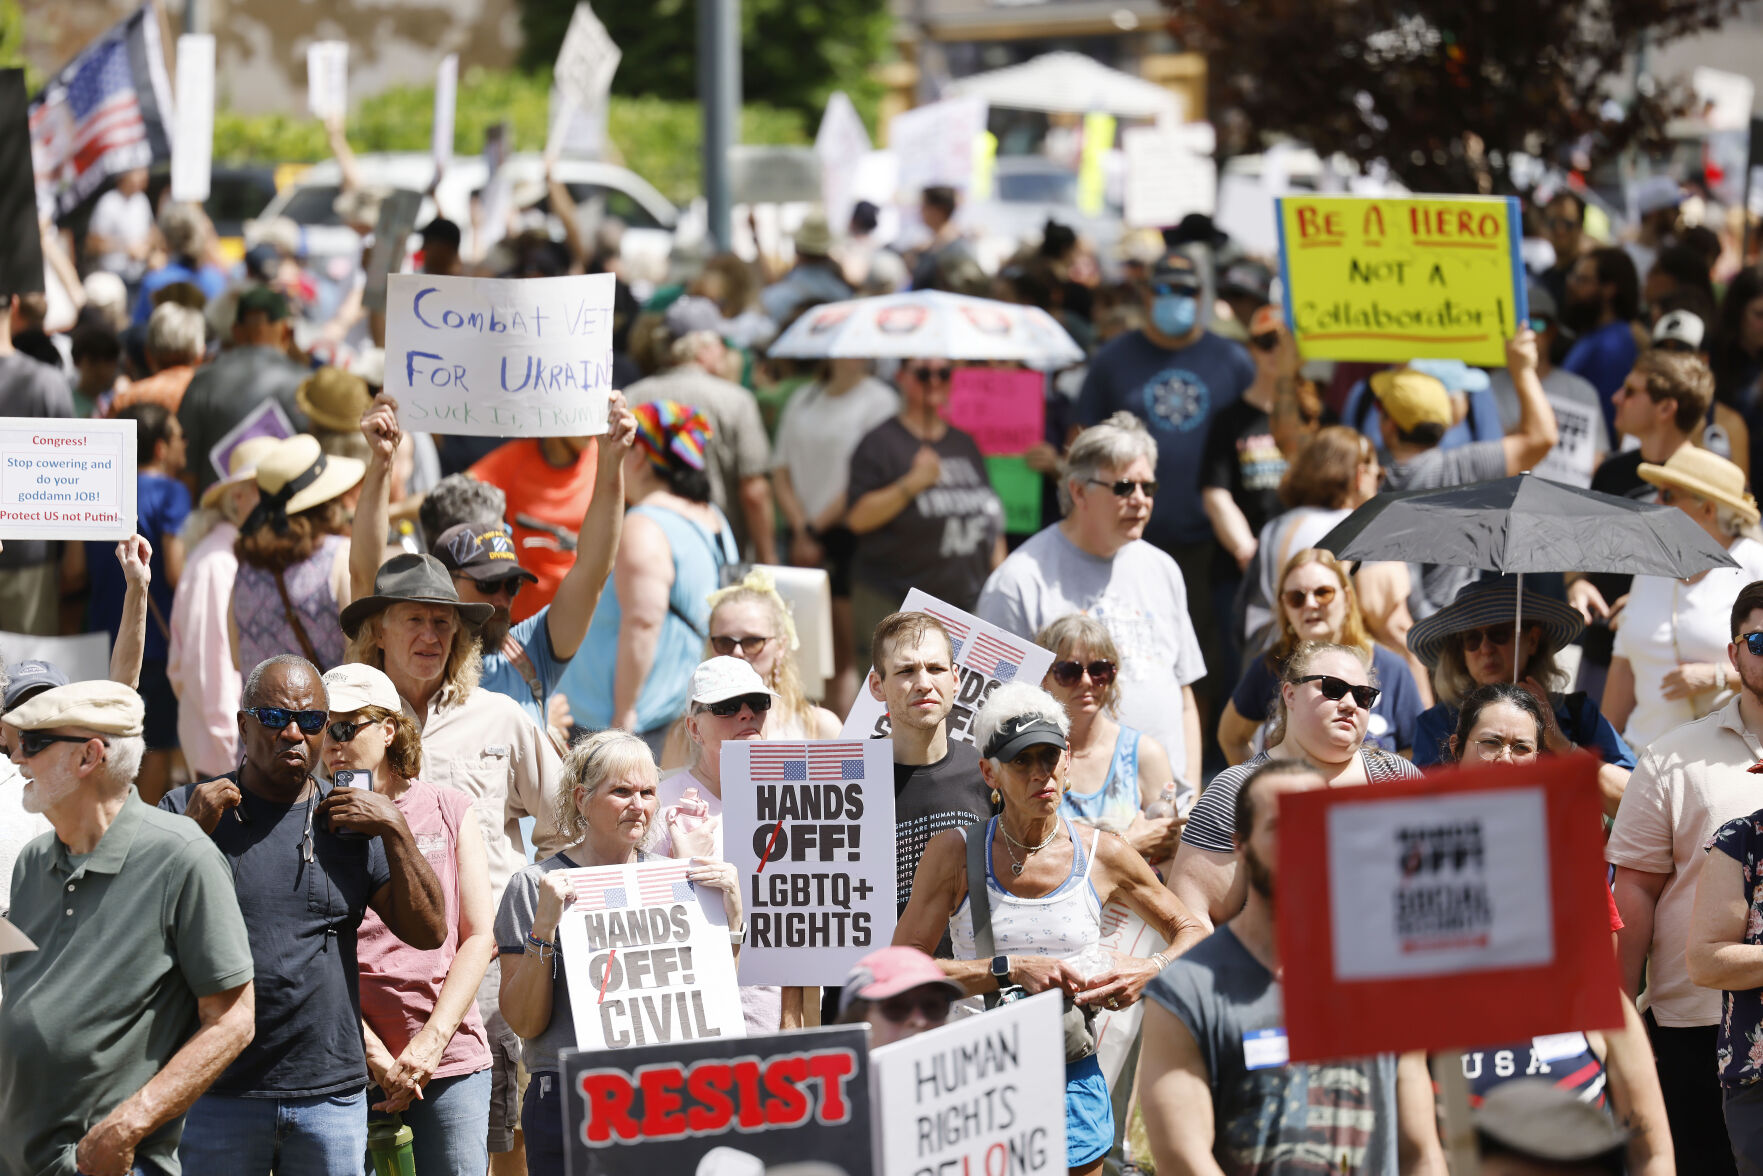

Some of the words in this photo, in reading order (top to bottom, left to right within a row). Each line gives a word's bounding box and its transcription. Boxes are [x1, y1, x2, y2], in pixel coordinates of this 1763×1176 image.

[1297, 205, 1345, 238] BE
[1363, 205, 1385, 236] A
[1410, 207, 1500, 238] HERO
[1350, 258, 1411, 285] NOT
[1428, 262, 1446, 286] A
[406, 350, 469, 393] FOR
[32, 435, 87, 448] Congress!
[7, 457, 33, 469] Stop
[36, 459, 87, 471] cowering
[91, 460, 112, 469] and
[36, 474, 51, 485] do
[54, 477, 80, 486] your
[18, 490, 72, 502] goddamn
[74, 491, 100, 502] JOB!
[0, 510, 41, 521] Protect
[44, 511, 59, 521] US
[62, 512, 81, 521] not
[84, 512, 118, 522] Putin!
[756, 783, 864, 821] HANDS
[895, 821, 912, 830] GHTS
[914, 816, 928, 824] ARE
[930, 811, 955, 819] HUMAN
[957, 810, 980, 822] RIGHTS
[752, 823, 861, 863] OFF!
[895, 829, 912, 838] GHTS
[914, 825, 928, 833] ARE
[930, 820, 956, 829] HUMAN
[751, 872, 874, 910] LGBTQ+
[584, 904, 691, 950] HANDS
[750, 911, 872, 948] RIGHTS
[588, 946, 696, 993] OFF!
[599, 989, 722, 1050] CIVIL
[914, 1022, 1020, 1104] HUMAN
[579, 1050, 855, 1145] RESIST
[916, 1085, 1017, 1158] RIGHTS
